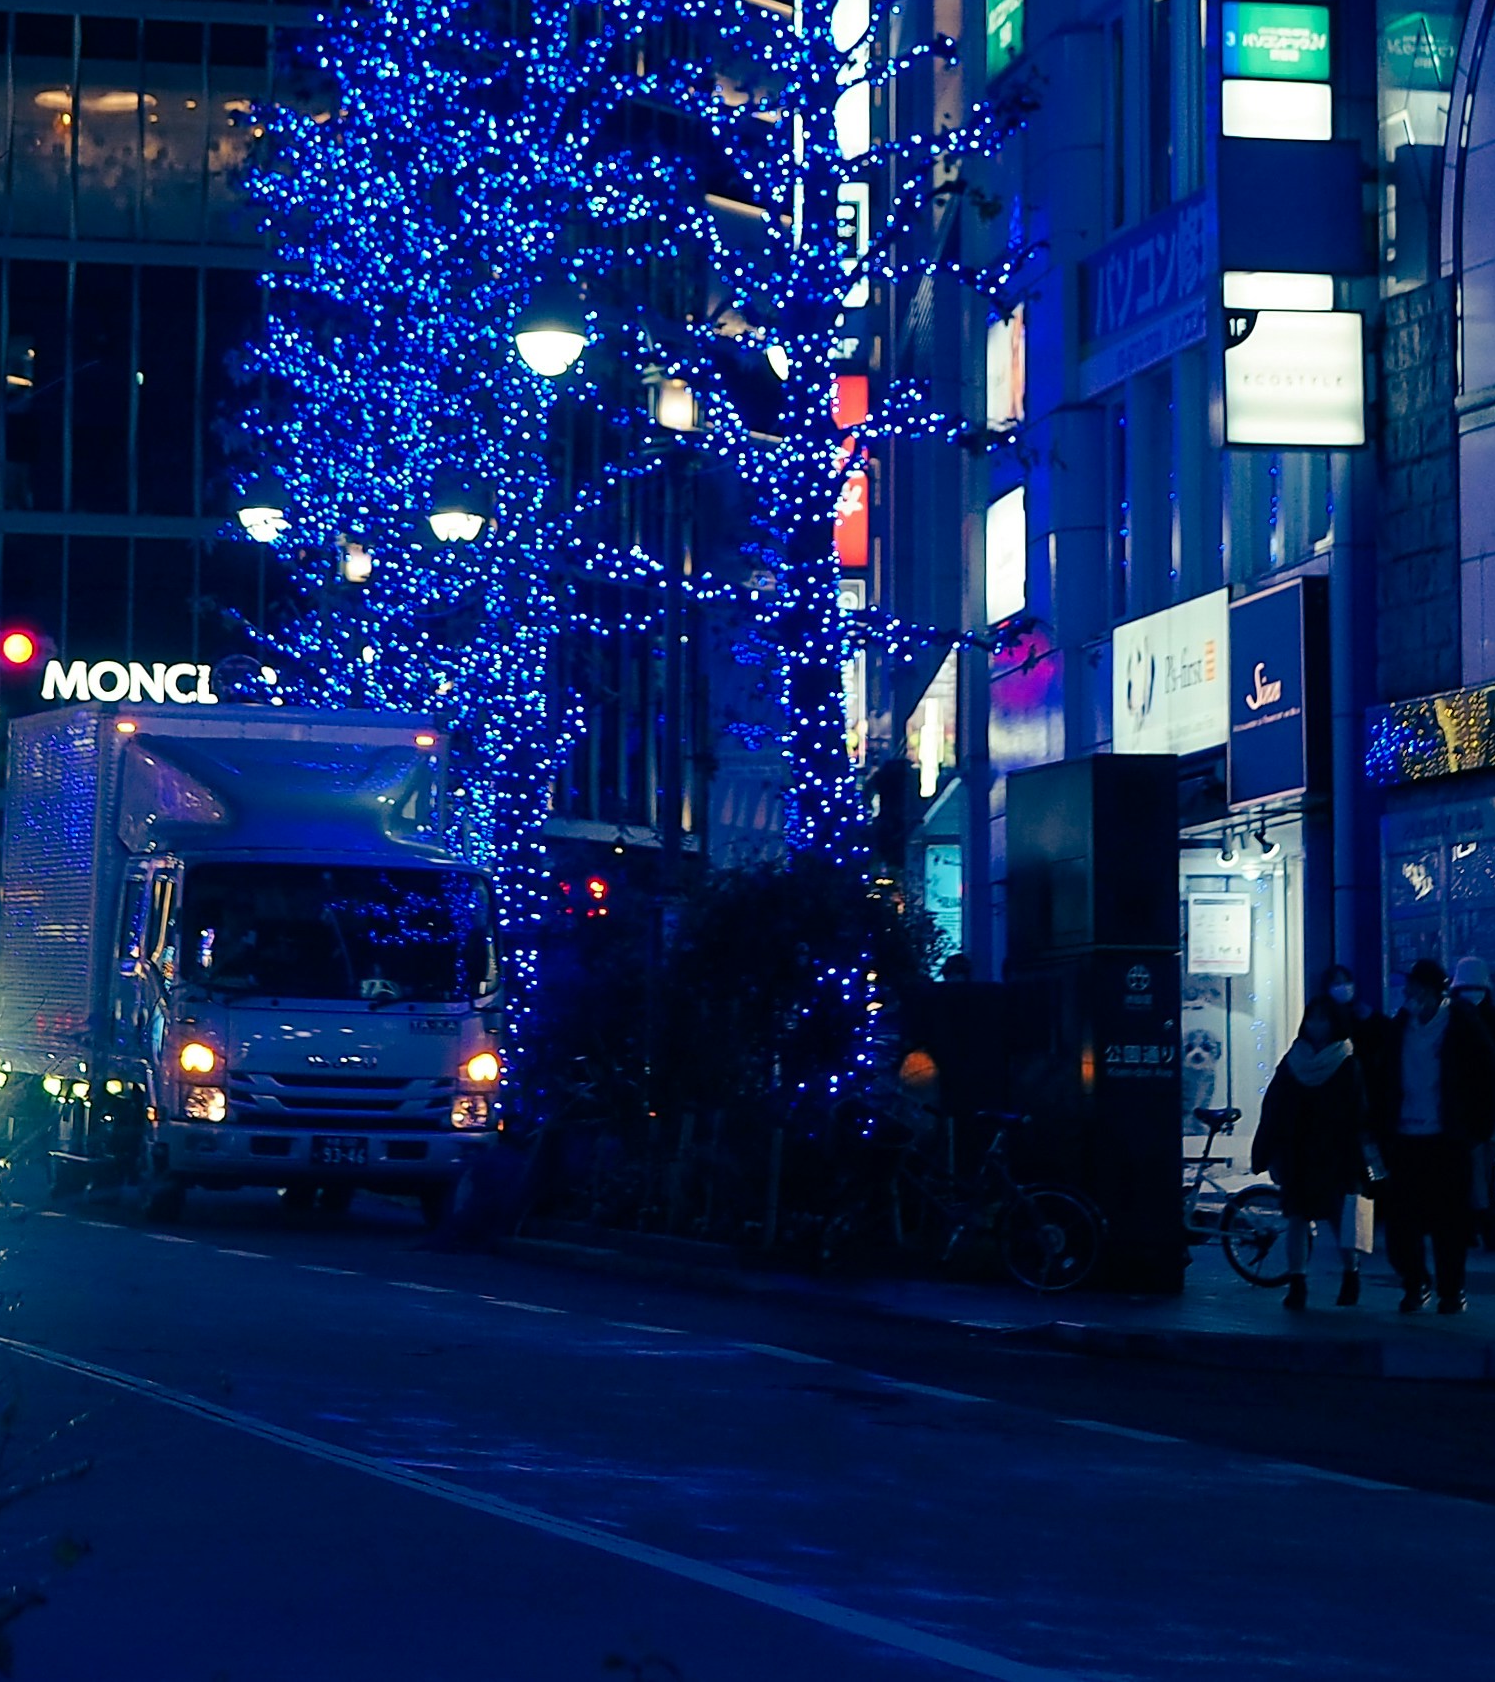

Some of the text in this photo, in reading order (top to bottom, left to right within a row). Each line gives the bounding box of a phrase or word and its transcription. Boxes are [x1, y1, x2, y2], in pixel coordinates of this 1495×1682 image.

[1225, 29, 1236, 47] 3
[1229, 317, 1248, 338] 1F
[1243, 373, 1345, 391] ECOSTYLE
[41, 659, 221, 705] MONCL
[1105, 1045, 1176, 1064] 公園通り
